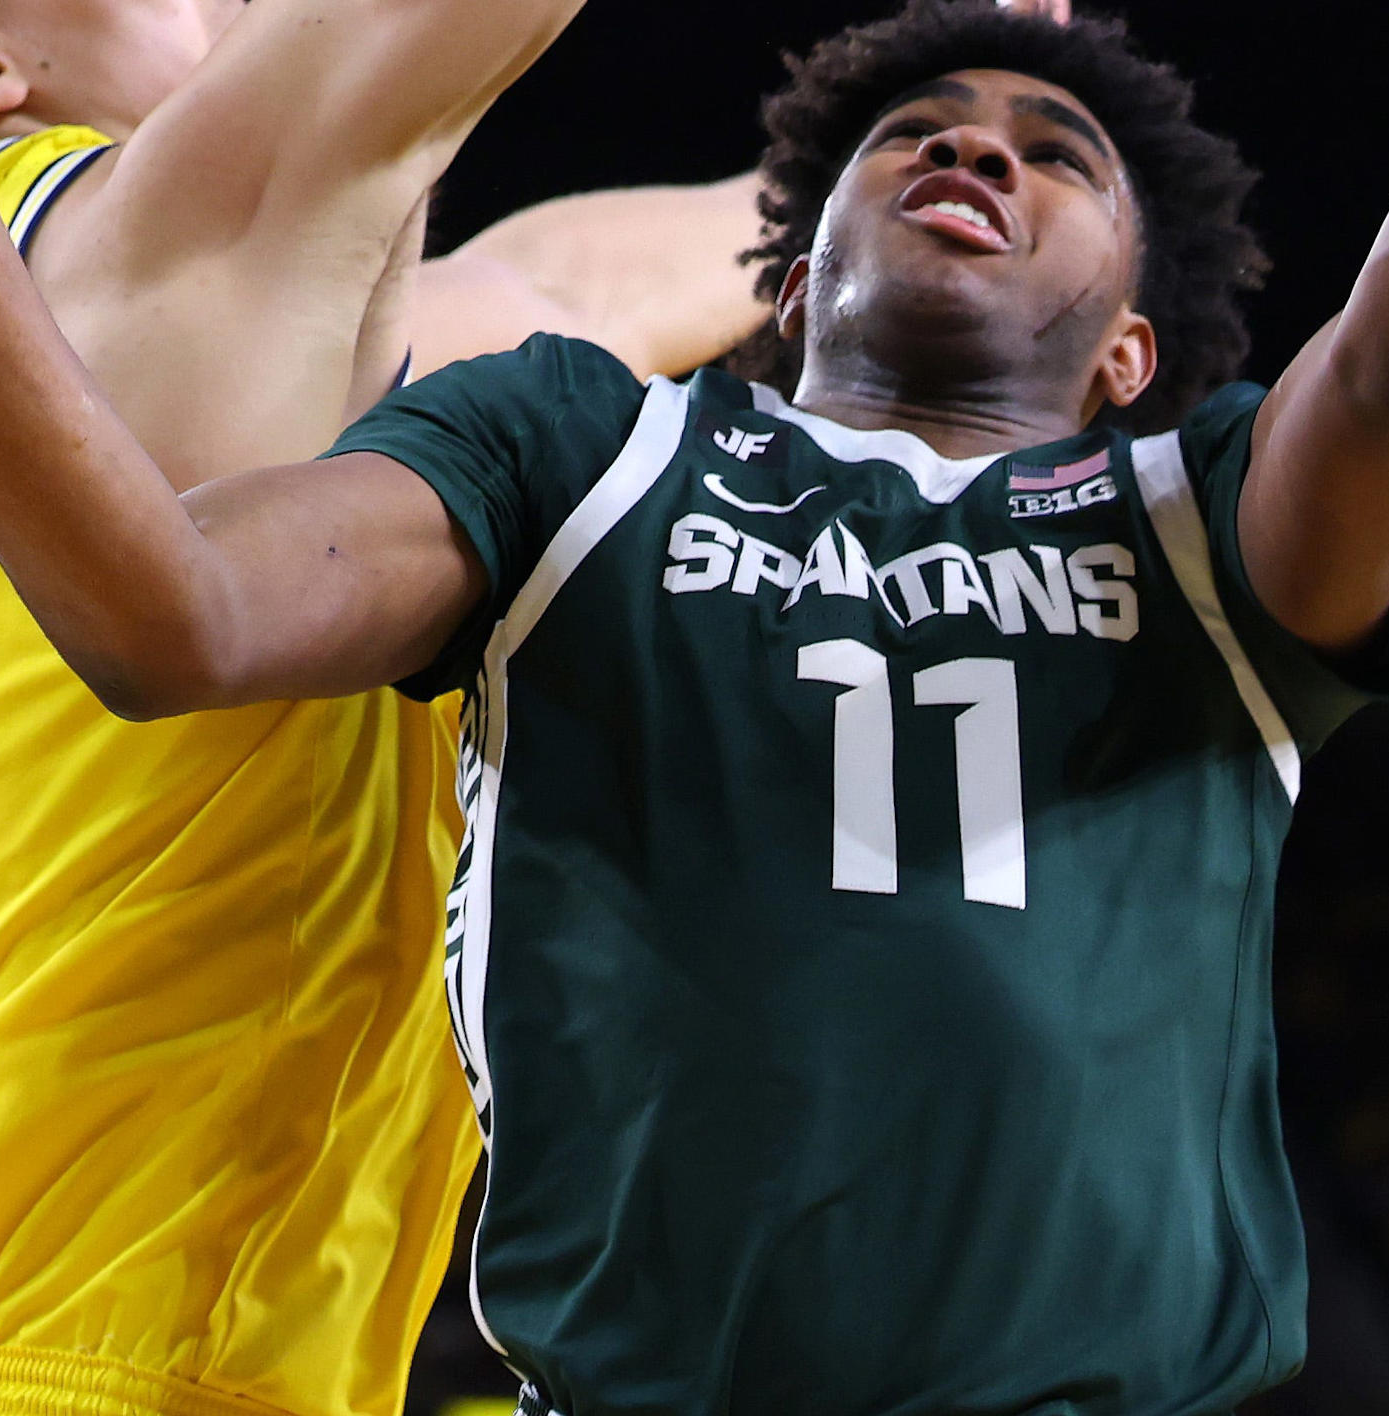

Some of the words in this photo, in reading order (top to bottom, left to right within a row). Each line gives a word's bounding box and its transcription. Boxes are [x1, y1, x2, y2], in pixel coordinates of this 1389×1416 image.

[712, 425, 776, 462] JF
[662, 513, 1140, 642] SPARTANS
[796, 638, 1027, 910] 11
